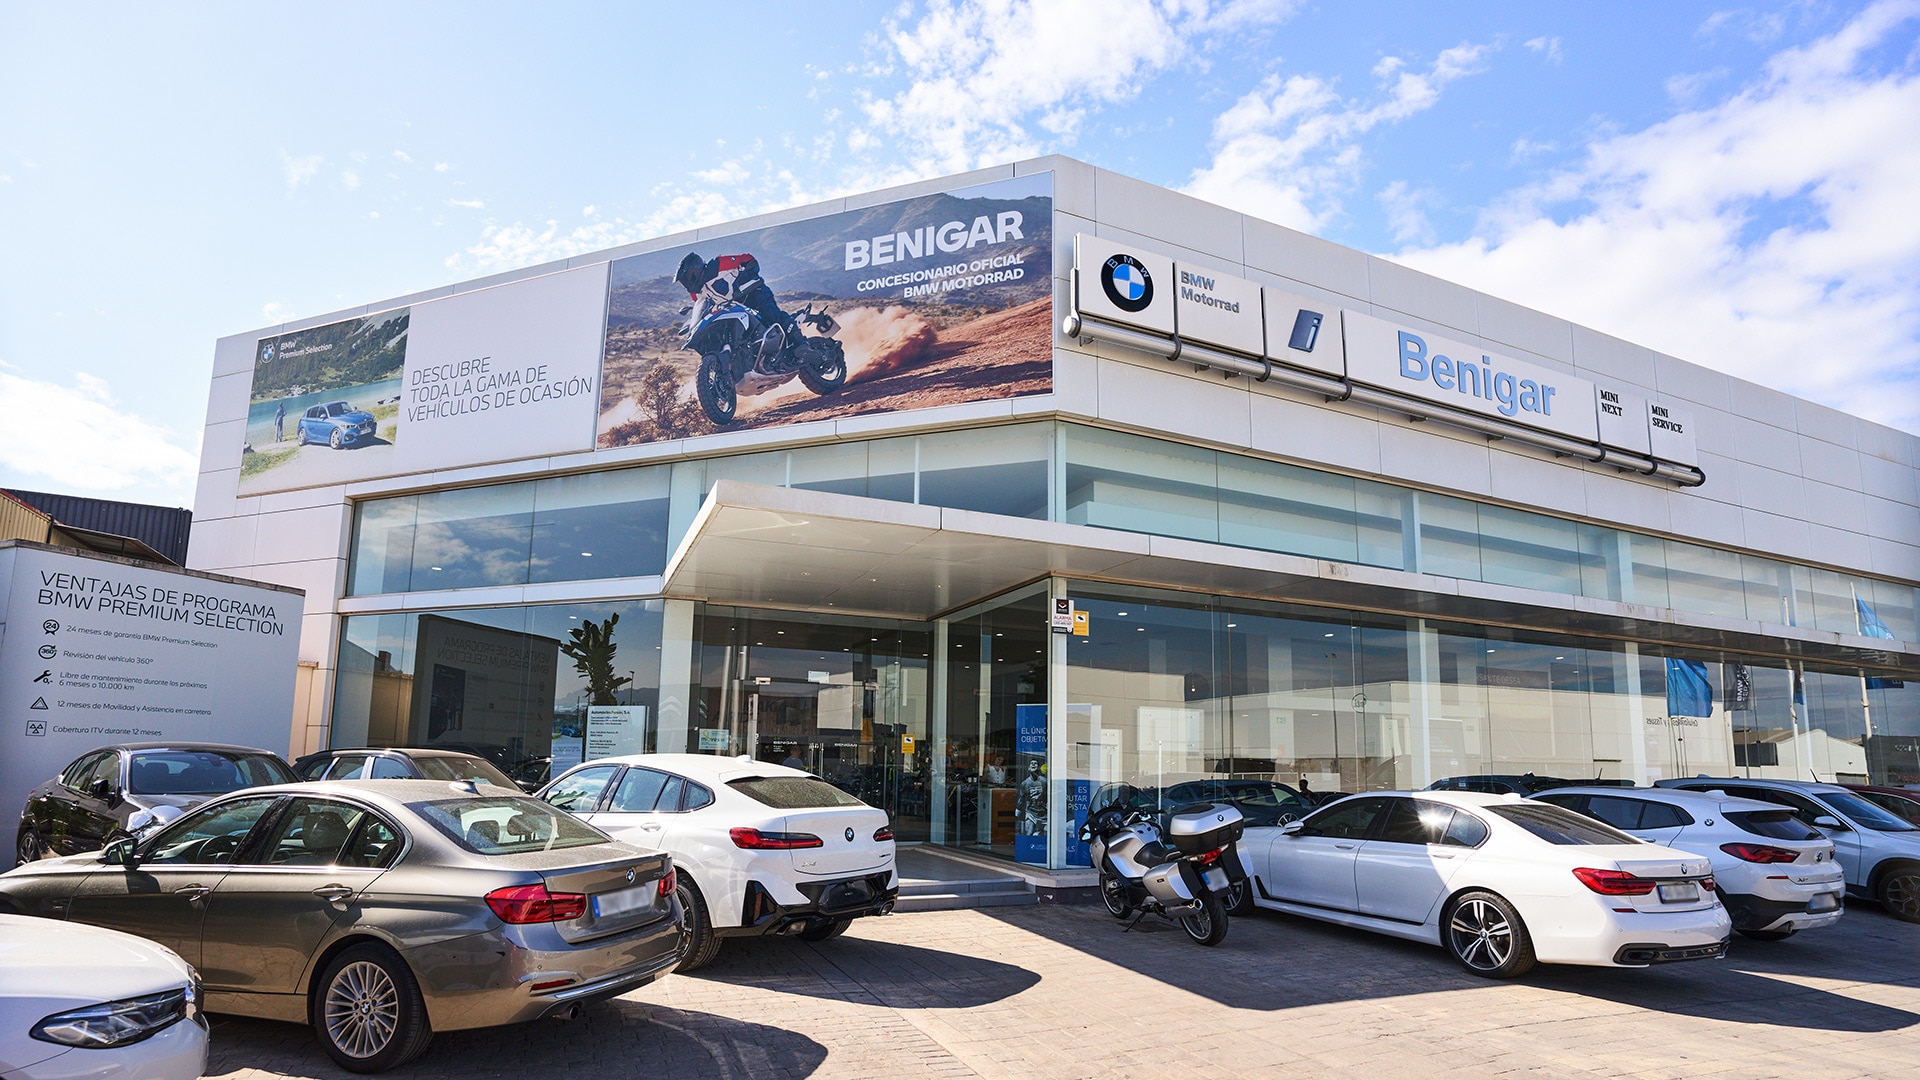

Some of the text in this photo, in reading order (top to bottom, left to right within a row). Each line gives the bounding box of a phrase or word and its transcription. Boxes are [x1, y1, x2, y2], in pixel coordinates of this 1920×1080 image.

[844, 210, 1025, 271] BENIGAR
[856, 252, 1025, 292] CONCESIONARIO OFICIAL
[1106, 255, 1150, 278] BMW
[903, 268, 1025, 298] BMW MOTORRAD
[1180, 270, 1216, 292] BMW
[1180, 286, 1240, 313] Motorrad
[279, 343, 333, 359] Premium Selection
[280, 340, 297, 351] BMW
[411, 356, 491, 386] DESCUBRE
[1397, 329, 1556, 417] Benigar
[410, 364, 548, 404] TODA LA GAMA DE
[407, 375, 593, 422] VEHÍCULOS DE OCASIÓN
[1599, 389, 1620, 405] MINI
[1600, 402, 1623, 417] NEXT
[1650, 404, 1669, 419] MINI
[1652, 416, 1684, 434] SERVICE
[41, 570, 276, 619] VENTAJAS DE PROGRAMA
[38, 589, 284, 636] BMW PREMIUM SELECTION
[78, 627, 101, 635] meses
[113, 631, 142, 640] garantía
[142, 634, 161, 642] BMW
[161, 636, 190, 645] Premium
[191, 639, 218, 648] Selection
[63, 650, 94, 660] Revisión
[107, 655, 135, 663] vehículo
[60, 671, 79, 680] Libre
[90, 675, 142, 684] mantenimiento
[143, 678, 168, 686] durante
[179, 681, 207, 689] próximos
[65, 680, 90, 688] meses
[98, 682, 123, 690] 10.000
[102, 703, 135, 711] Movilidad
[141, 705, 174, 713] Asistencia
[52, 725, 89, 734] Cobertura
[90, 726, 103, 734] ITV
[104, 727, 131, 735] durante
[140, 729, 162, 737] meses
[1020, 735, 1047, 743] OBJETI
[1021, 726, 1047, 735] EL ÚNIC
[1067, 802, 1088, 811] PISTA
